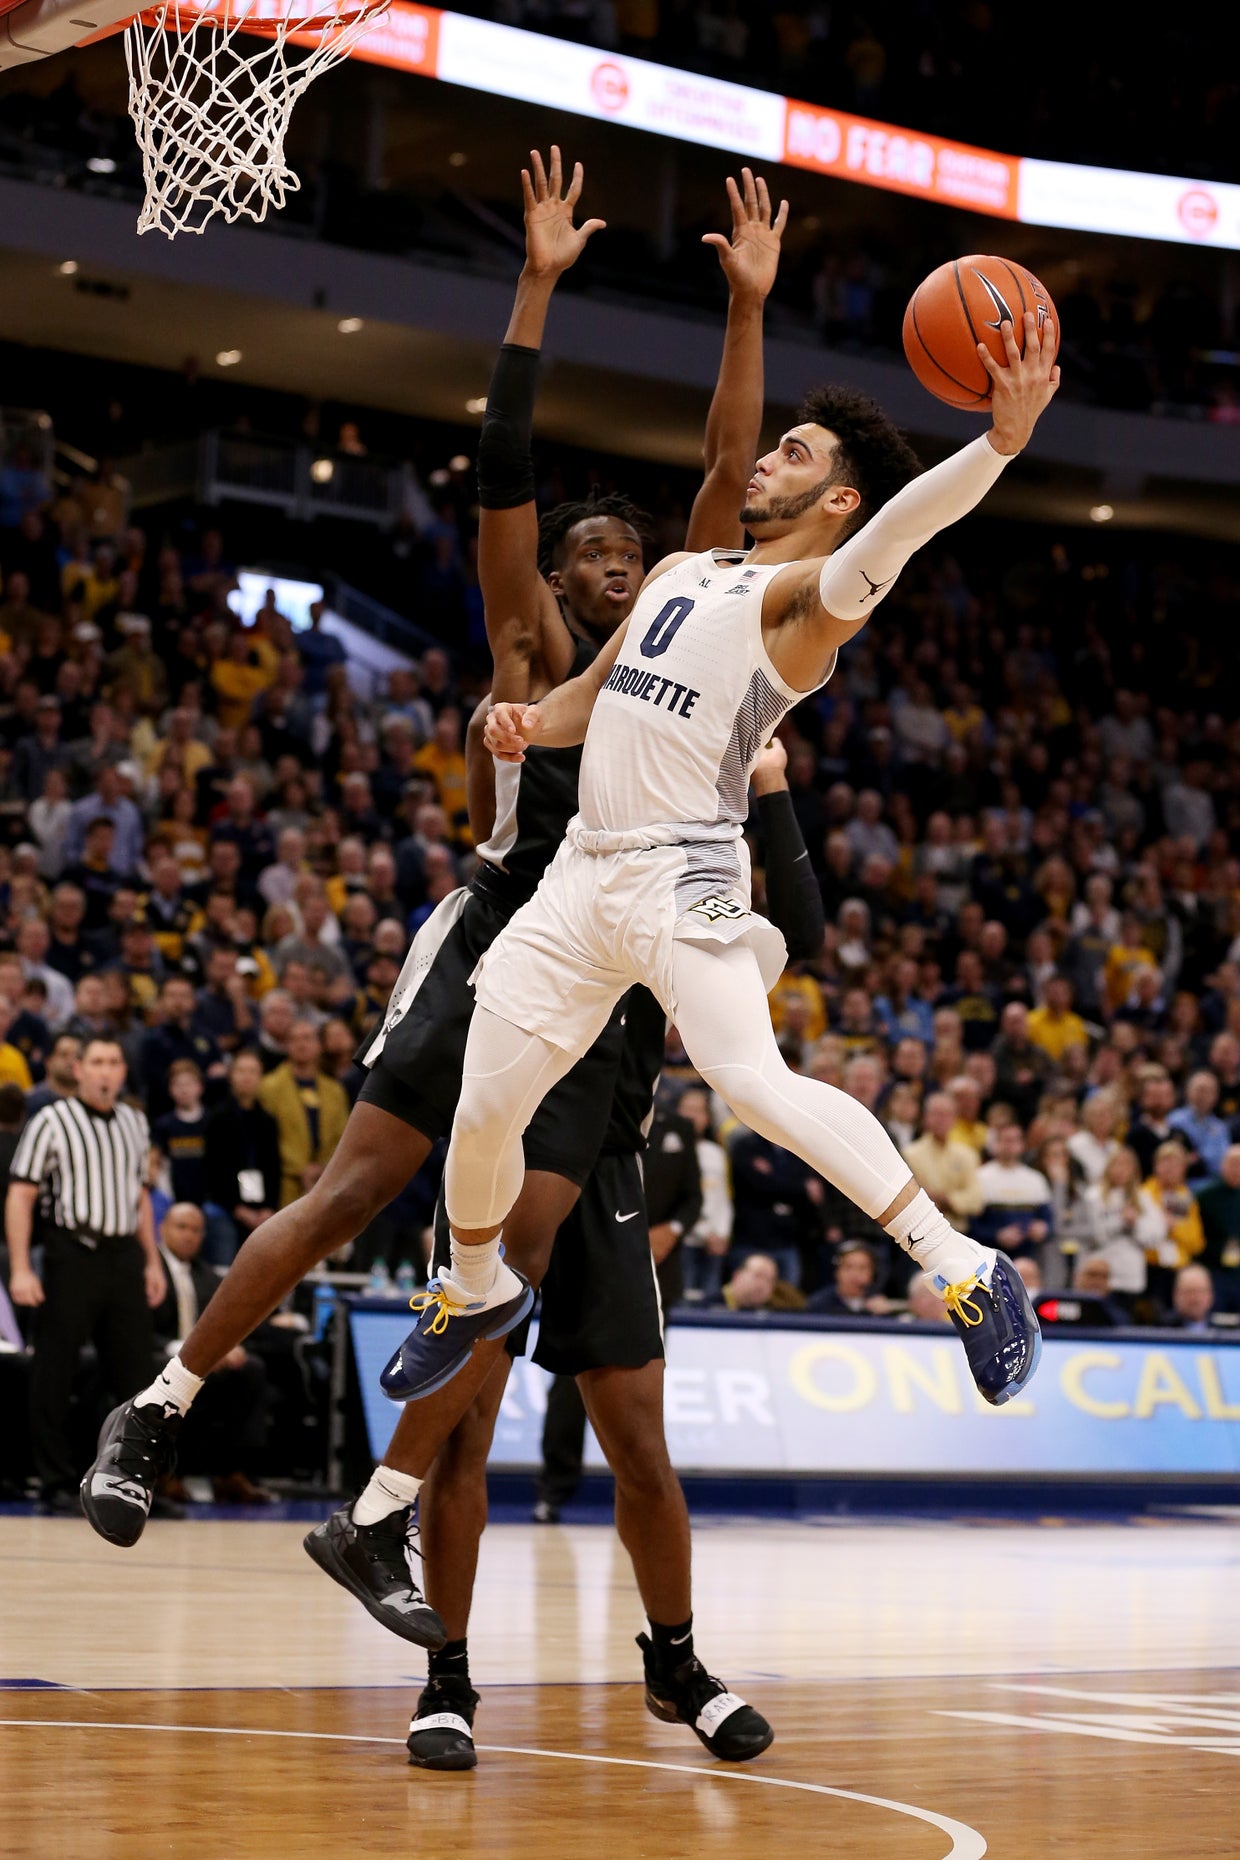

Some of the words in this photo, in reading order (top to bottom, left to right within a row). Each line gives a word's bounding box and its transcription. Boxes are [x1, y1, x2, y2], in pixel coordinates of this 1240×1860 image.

[787, 110, 841, 164] NO
[846, 125, 934, 188] FEAR
[640, 596, 695, 658] 0
